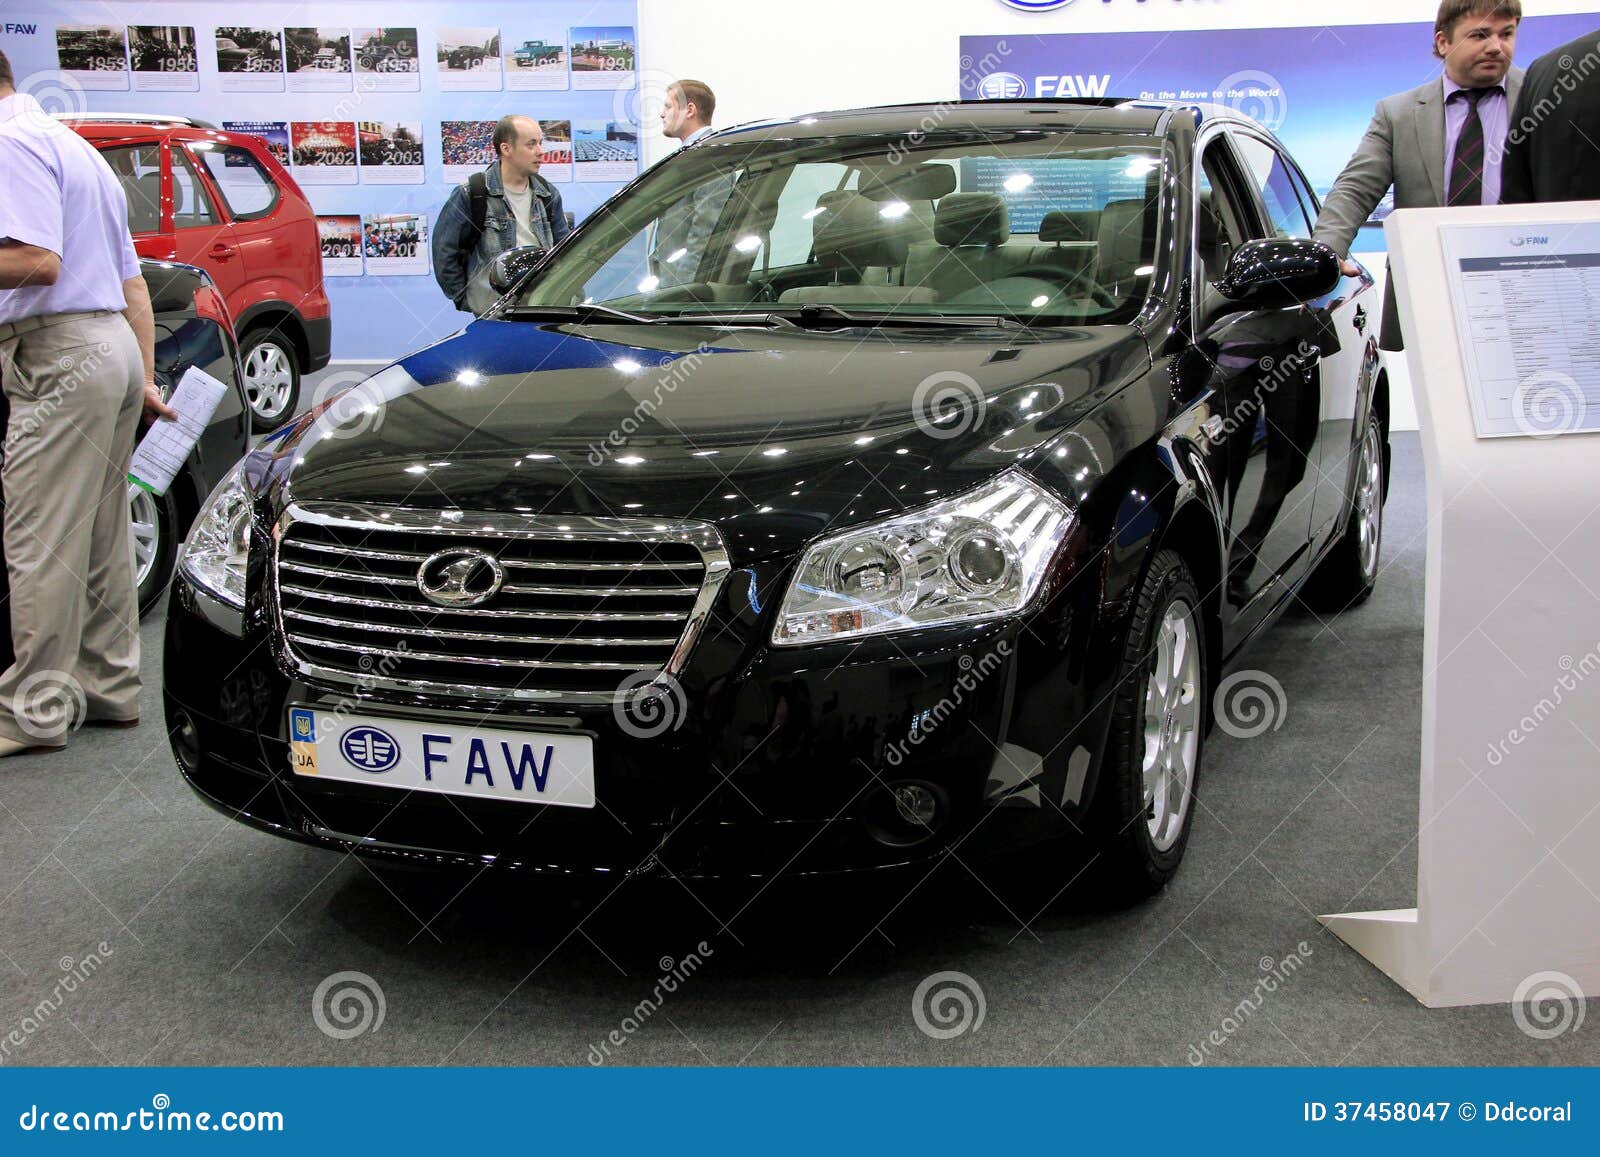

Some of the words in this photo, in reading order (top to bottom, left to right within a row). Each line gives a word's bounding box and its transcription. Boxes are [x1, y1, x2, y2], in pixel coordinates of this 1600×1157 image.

[5, 23, 37, 35] FAW
[157, 57, 197, 72] 1956
[599, 57, 634, 71] 1991
[1035, 74, 1111, 98] FAW
[1140, 91, 1155, 100] On
[1158, 91, 1176, 99] the
[1179, 90, 1208, 99] Move
[1212, 90, 1223, 98] to
[1227, 89, 1244, 98] the
[1248, 88, 1280, 97] World
[384, 150, 422, 164] 2003
[1526, 236, 1549, 245] FAW
[297, 754, 315, 768] UA
[422, 733, 554, 792] FAW
